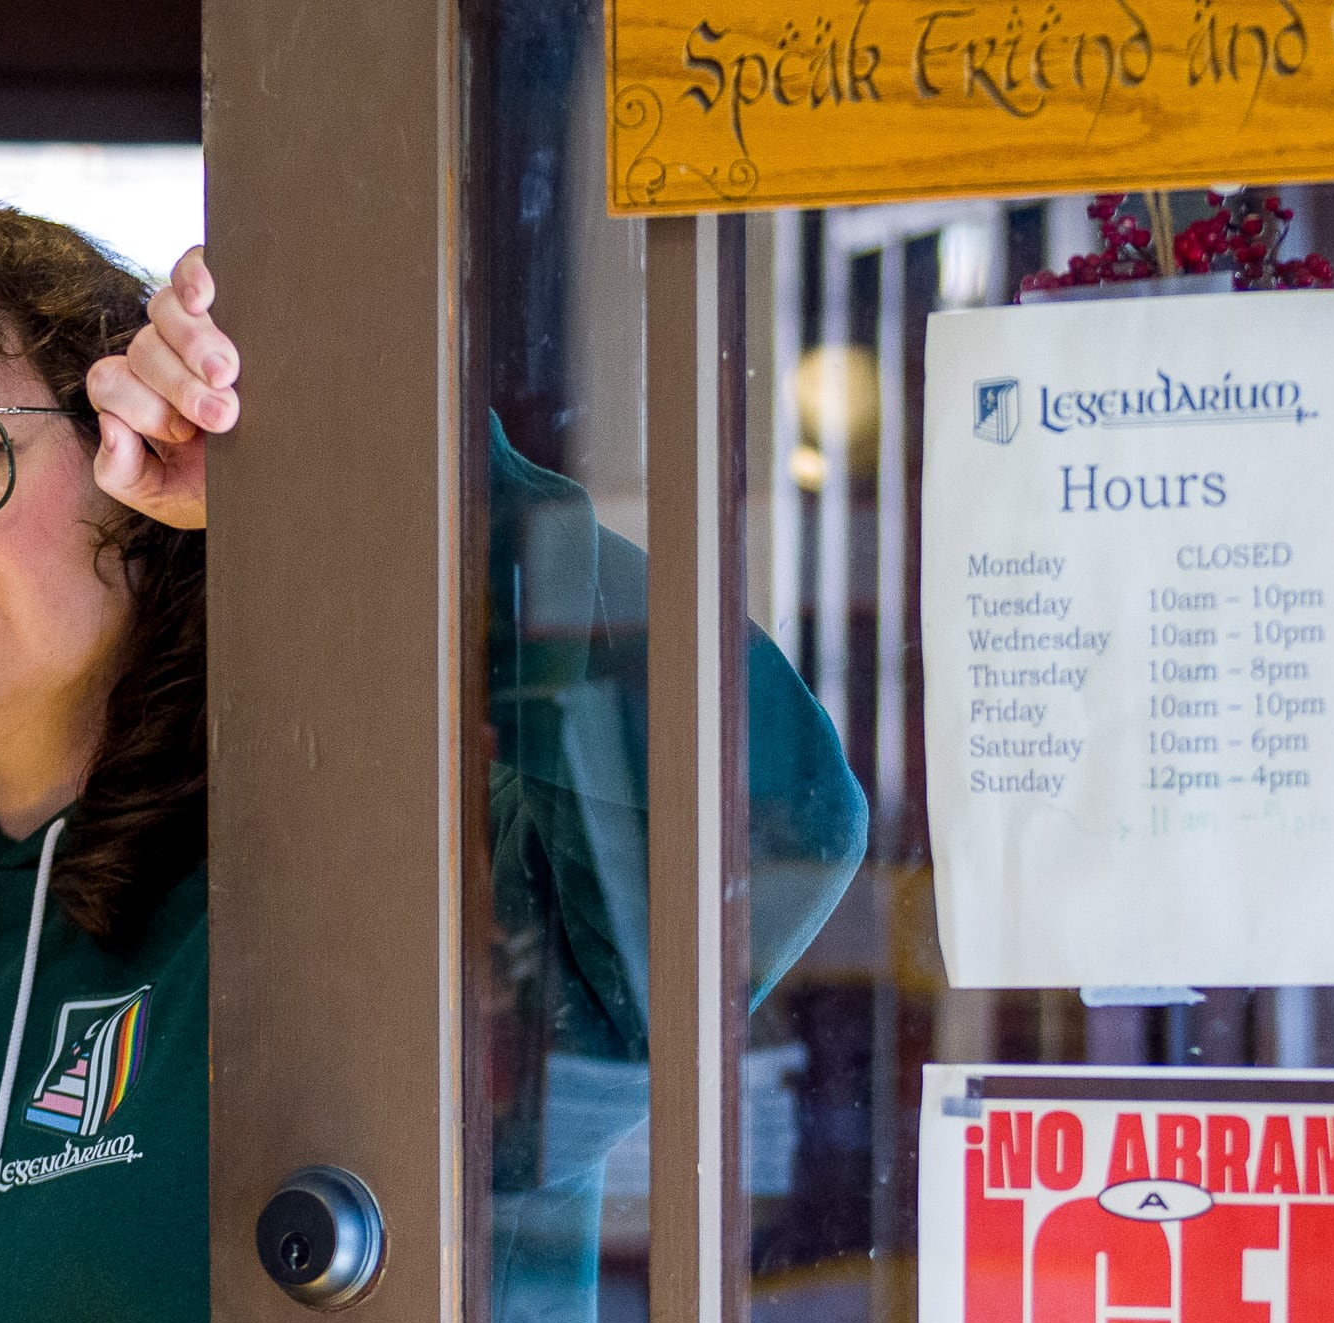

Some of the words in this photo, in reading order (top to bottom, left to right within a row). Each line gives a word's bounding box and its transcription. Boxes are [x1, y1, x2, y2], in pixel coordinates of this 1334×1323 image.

[1061, 464, 1227, 512] Hours
[967, 551, 1066, 580] Monday
[1176, 541, 1294, 571] CLOSED
[966, 591, 1073, 621] Tuesday
[1149, 587, 1218, 613] 10am
[1253, 583, 1325, 616] 10pm
[968, 626, 1112, 656] Wednesday
[1149, 622, 1219, 649] 10am
[1254, 619, 1326, 650] 10pm
[968, 661, 1089, 692] Thursday
[1149, 658, 1219, 684] 10am
[1250, 655, 1310, 686] 8pm
[970, 697, 1047, 728] Friday
[1149, 693, 1219, 720] 10am
[1254, 691, 1326, 721] 10pm
[969, 732, 1084, 763] Saturday
[1149, 729, 1219, 756] 10am
[1250, 726, 1310, 759] 6pm
[969, 768, 1066, 798] Sunday
[1148, 765, 1220, 798] 12pm
[1250, 764, 1311, 794] 4pm
[1137, 1191, 1169, 1211] A
